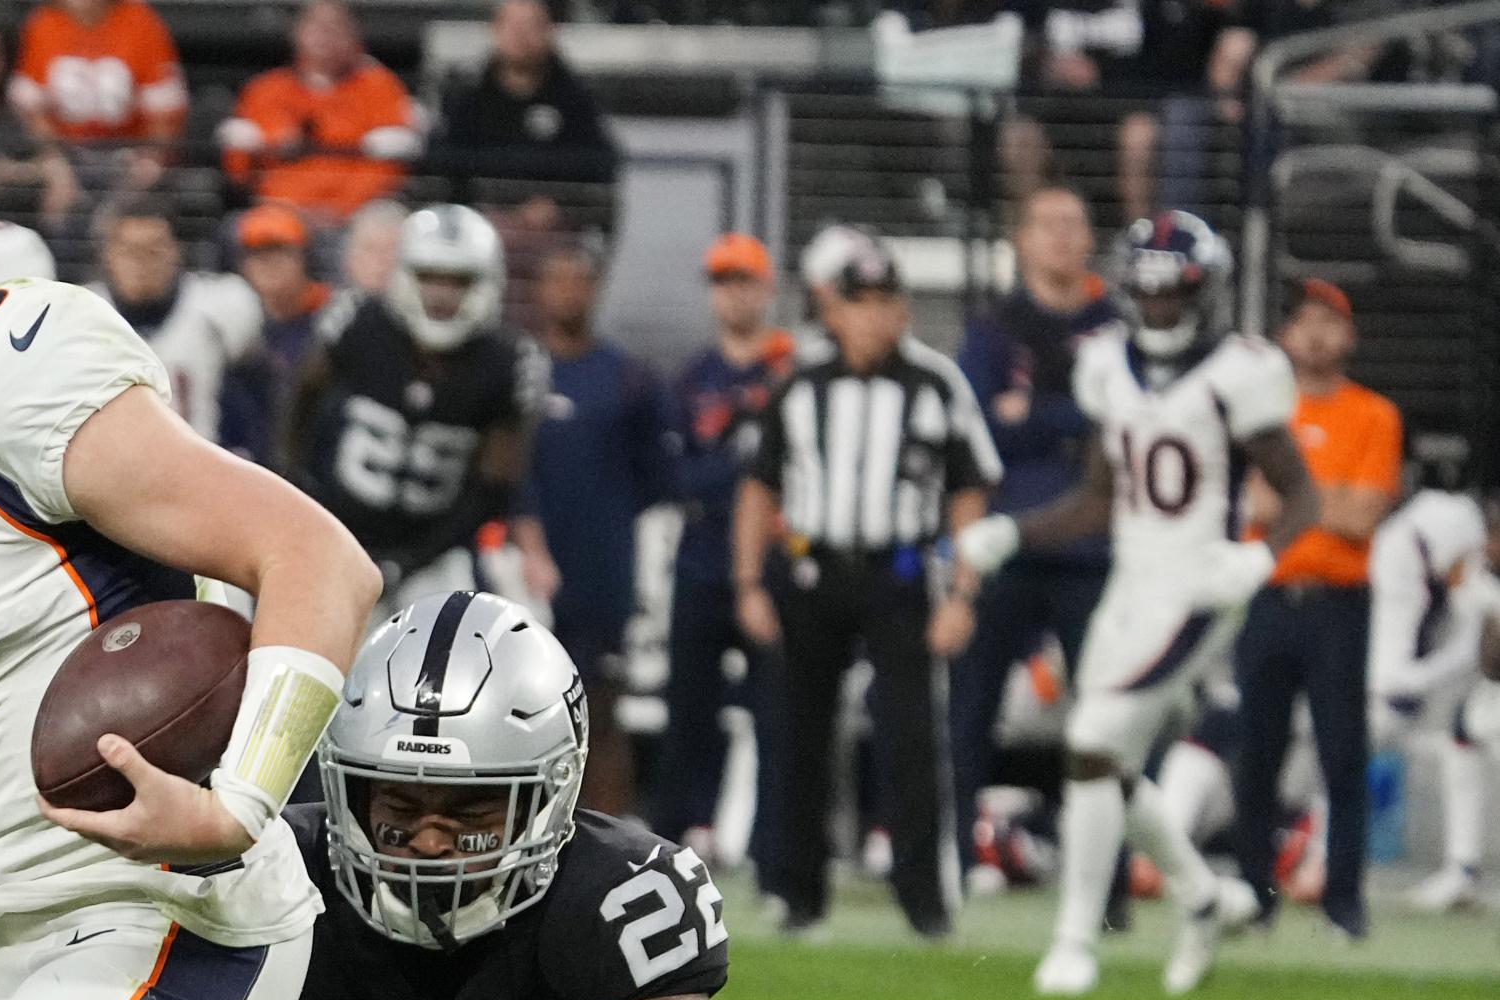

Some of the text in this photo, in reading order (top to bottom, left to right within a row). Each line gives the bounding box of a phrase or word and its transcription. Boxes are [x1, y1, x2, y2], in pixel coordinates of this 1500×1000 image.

[1118, 428, 1202, 517] 10
[397, 740, 451, 755] RAIDERS
[457, 833, 500, 852] KING
[600, 846, 729, 988] 22
